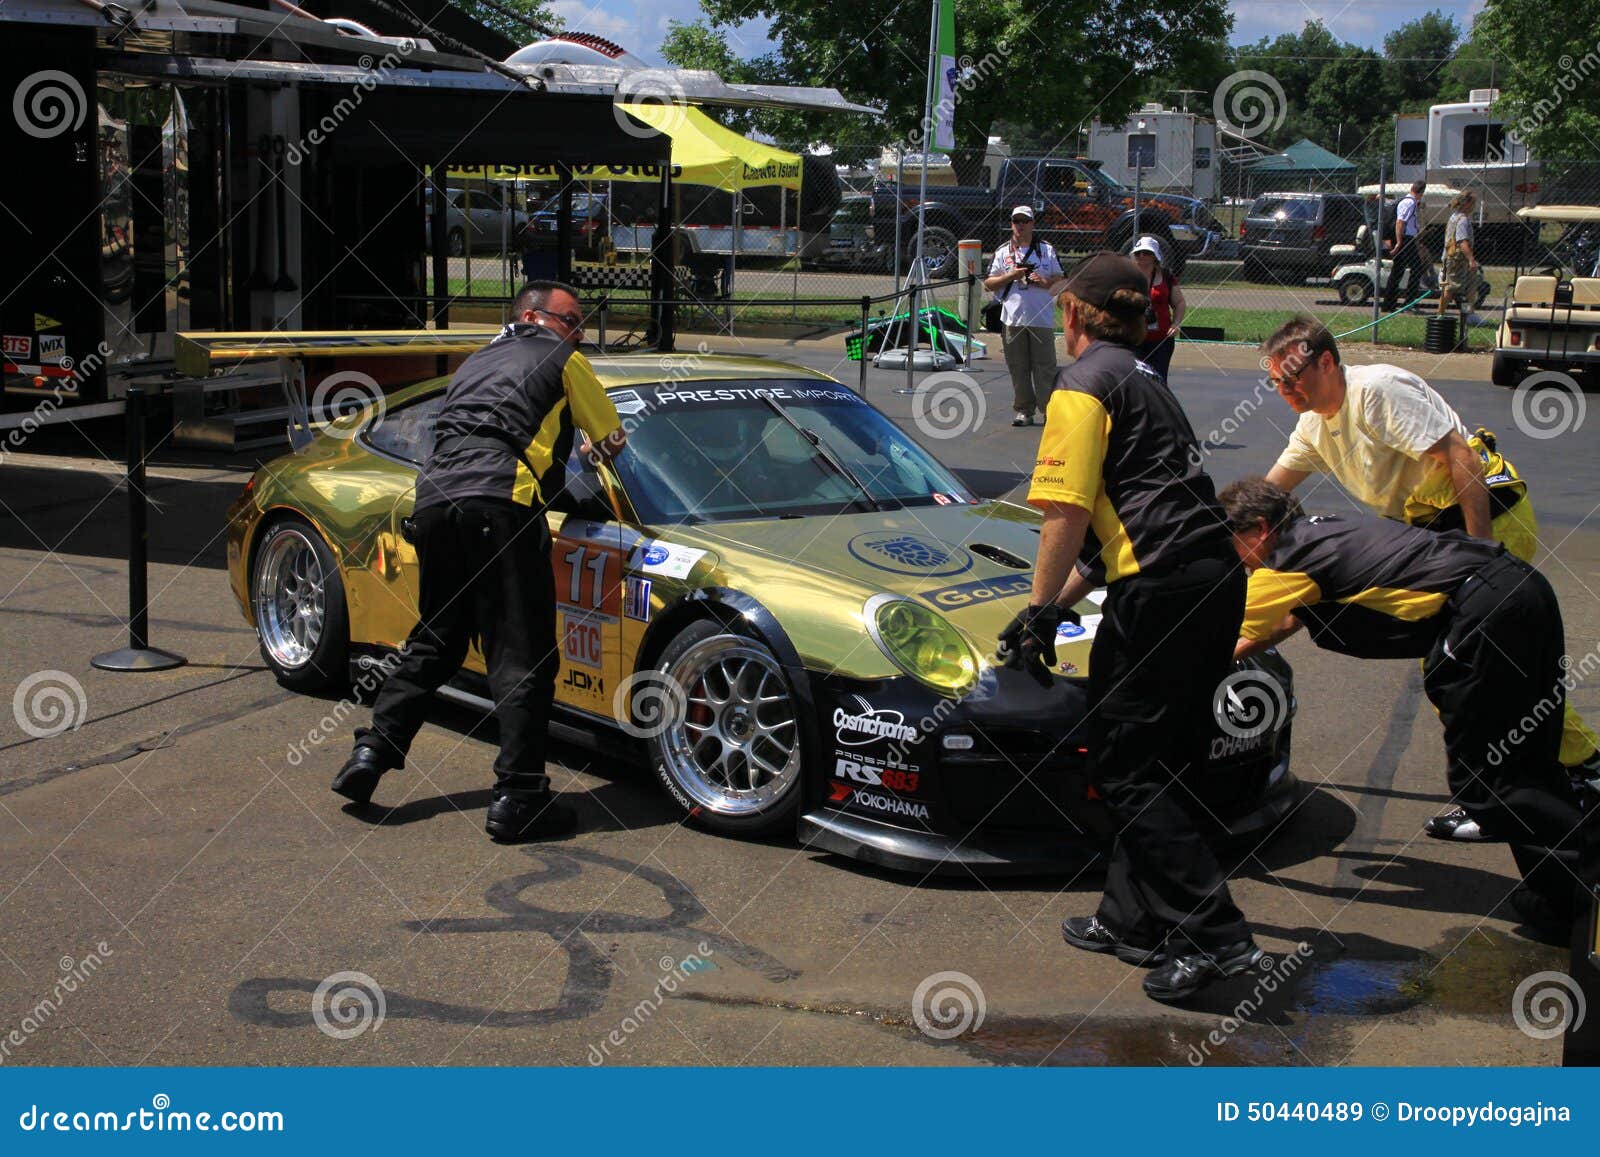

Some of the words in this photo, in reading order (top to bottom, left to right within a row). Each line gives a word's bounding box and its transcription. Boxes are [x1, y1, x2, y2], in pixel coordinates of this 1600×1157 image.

[40, 338, 64, 353] WIX
[656, 389, 793, 405] PRESTIGE
[564, 545, 609, 609] 11
[566, 621, 600, 663] GTC
[833, 707, 917, 742] Cosmichrome
[658, 763, 691, 811] YOKOHAMA
[853, 789, 930, 819] YOKOHAMA
